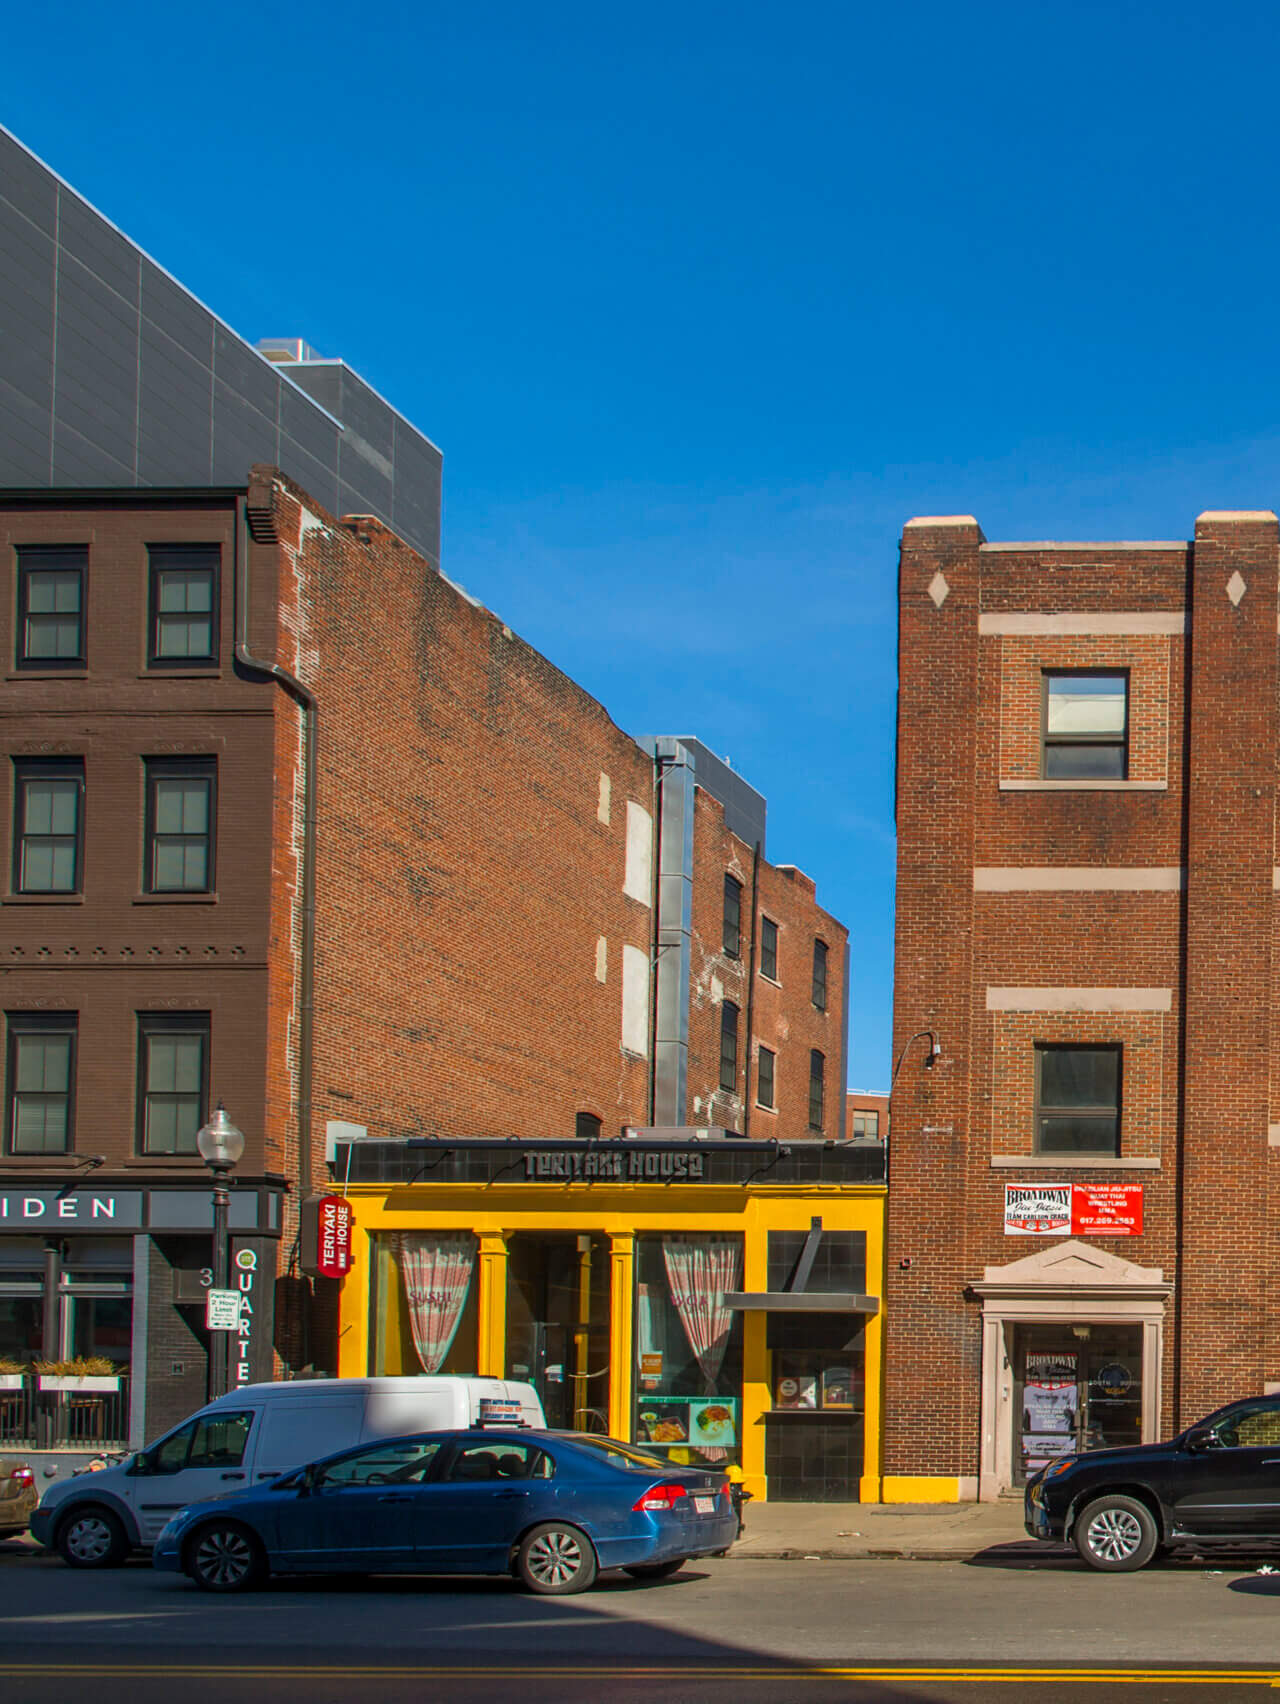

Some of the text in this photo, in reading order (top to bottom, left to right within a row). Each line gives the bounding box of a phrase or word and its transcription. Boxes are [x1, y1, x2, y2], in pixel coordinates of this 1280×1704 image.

[1007, 1190, 1070, 1206] BROADWAY
[323, 1204, 336, 1267] TERIYAKI
[337, 1206, 348, 1246] HOUSE
[236, 1249, 257, 1390] QUARTE
[1026, 1355, 1077, 1369] BROADWAY
